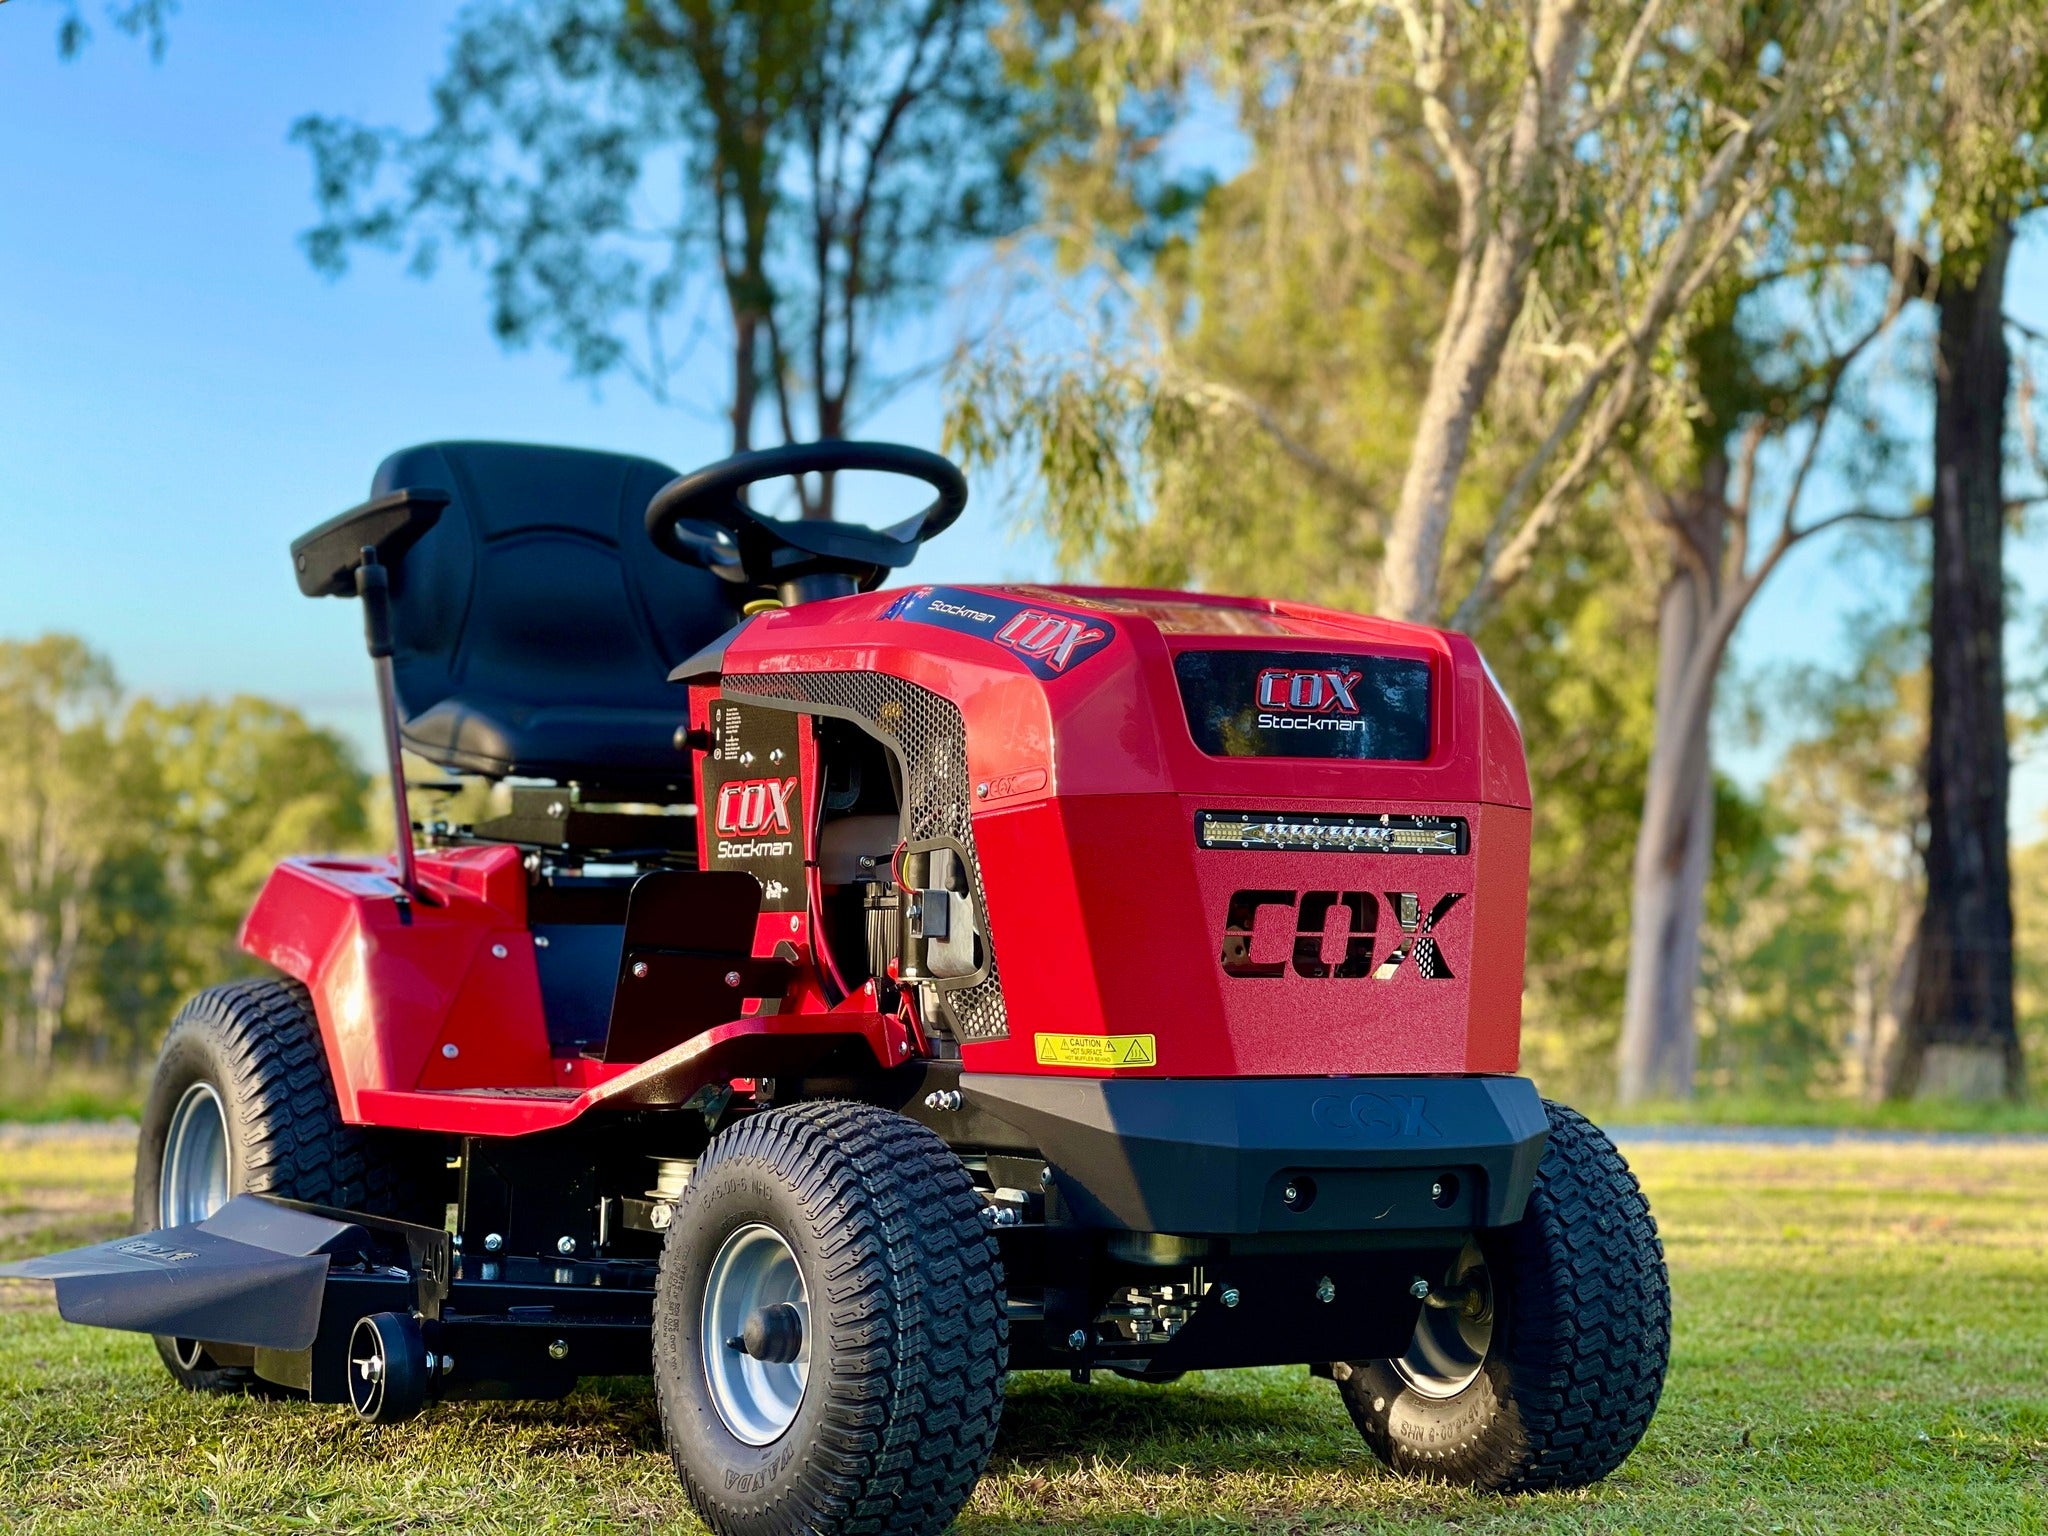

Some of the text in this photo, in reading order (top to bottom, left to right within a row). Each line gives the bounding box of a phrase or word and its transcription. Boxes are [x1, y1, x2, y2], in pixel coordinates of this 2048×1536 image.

[928, 600, 996, 624] Stockman
[996, 610, 1102, 669] COX
[1258, 670, 1361, 712] COX
[1257, 715, 1365, 731] Stockman
[717, 779, 796, 834] COX
[717, 839, 792, 859] Stockman
[1221, 889, 1467, 979] COX
[1070, 1038, 1101, 1047] CAUTION
[1081, 1048, 1102, 1056] SURFACE
